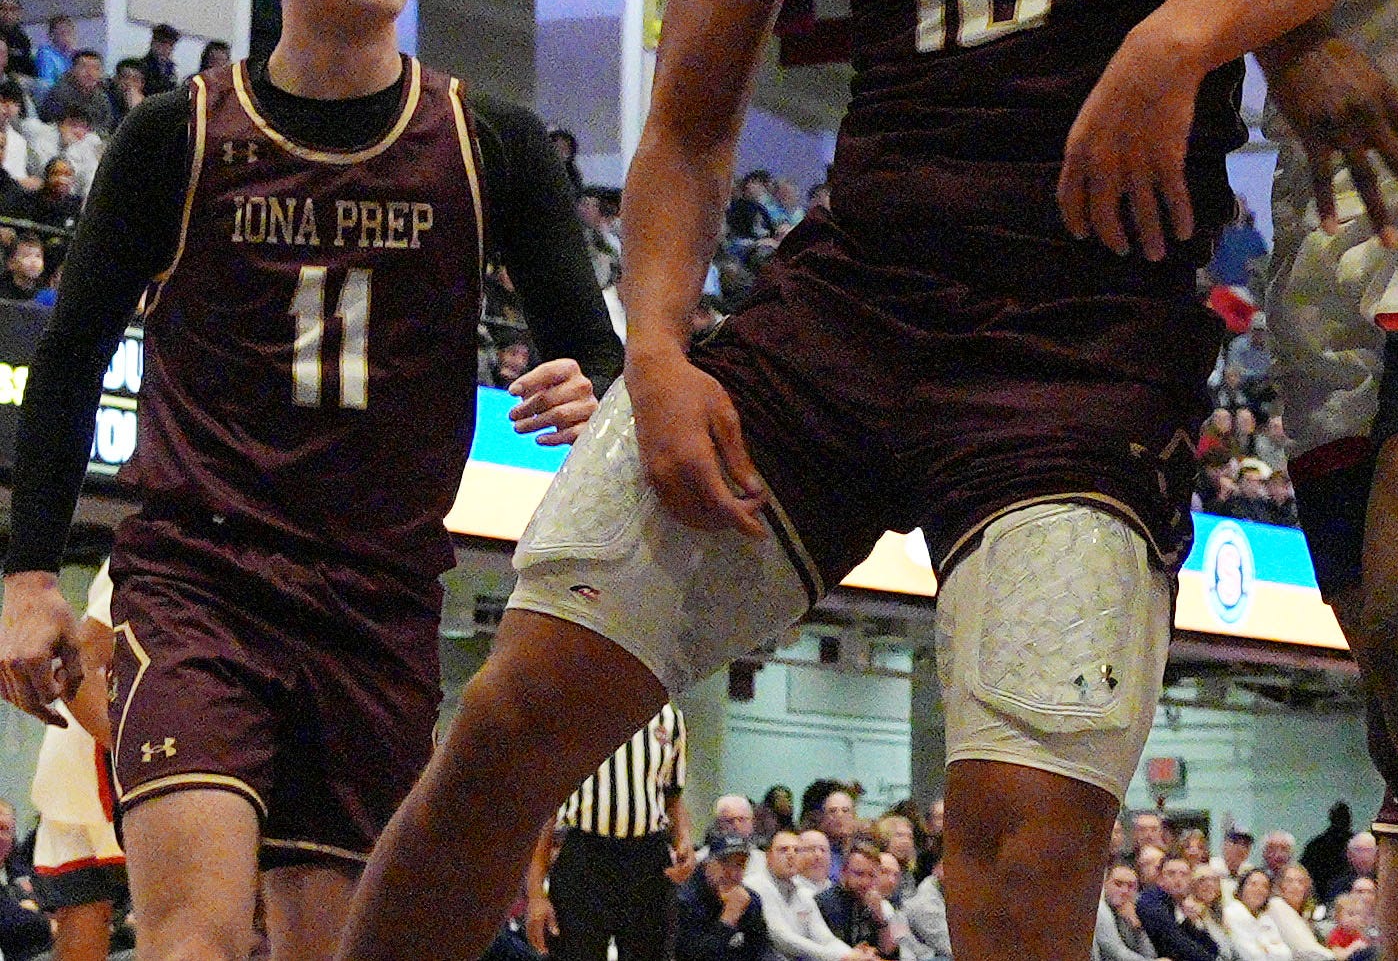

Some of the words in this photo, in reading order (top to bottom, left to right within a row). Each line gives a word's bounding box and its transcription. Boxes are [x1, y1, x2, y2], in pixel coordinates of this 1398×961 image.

[231, 195, 321, 247] IONA
[333, 199, 434, 249] PREP
[287, 265, 373, 411] 11
